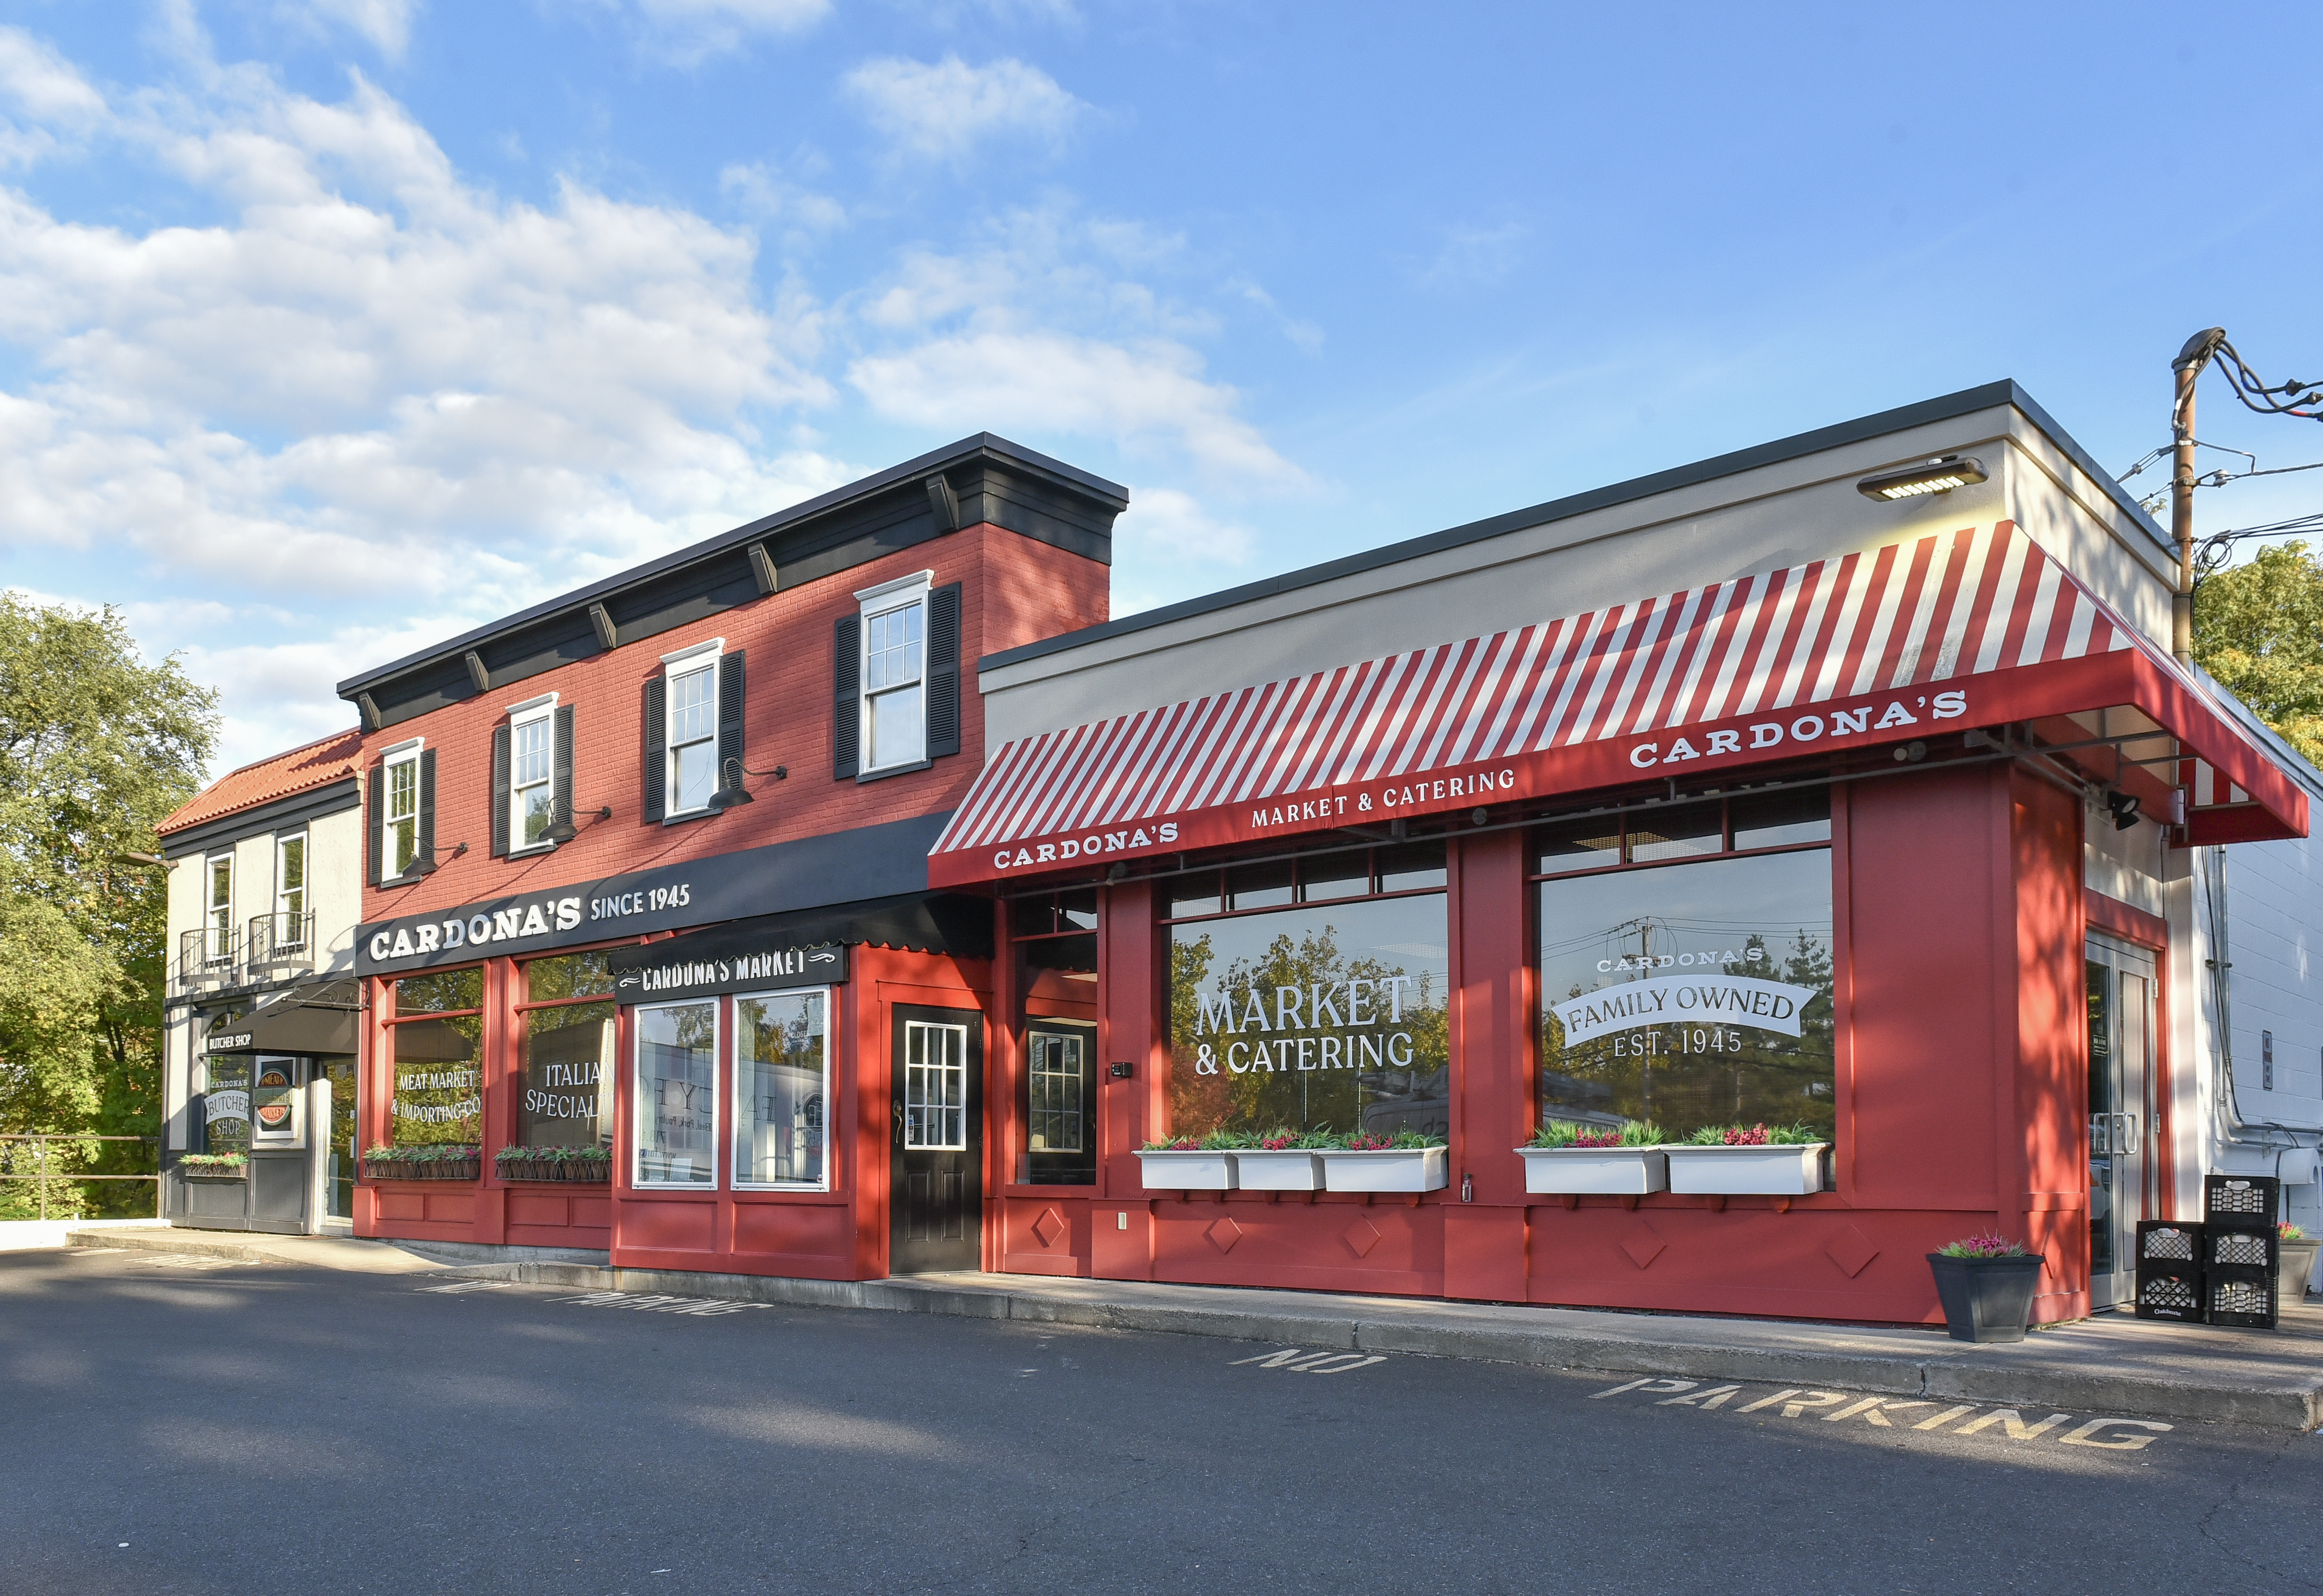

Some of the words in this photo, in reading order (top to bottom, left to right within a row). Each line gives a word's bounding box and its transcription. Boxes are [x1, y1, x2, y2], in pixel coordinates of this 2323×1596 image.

[1630, 690, 1967, 768] CARDONA'S
[1252, 796, 1347, 828] MARKET
[1358, 793, 1373, 811] &
[1383, 769, 1515, 808] CATERING
[994, 822, 1178, 869] CARDONA'S
[369, 897, 580, 961] CARDONA'S
[591, 892, 644, 921] SINCE
[649, 884, 690, 910] 1945
[736, 948, 804, 980] MARKET
[1596, 947, 1763, 973] CARDONA'S
[1196, 976, 1412, 1035] MARKET
[1567, 988, 1668, 1033] FAMILY
[1676, 986, 1794, 1019] OWNED
[209, 1036, 234, 1049] BUTCHER
[235, 1034, 251, 1046] SHOP
[1196, 1043, 1219, 1075] &
[1227, 1032, 1414, 1074] CATERING
[1615, 1032, 1668, 1057] EST.
[1682, 1029, 1742, 1053] 1945
[211, 1079, 247, 1088] CARDONA'S
[264, 1074, 280, 1085] MEAT
[399, 1074, 427, 1090] MEAT
[430, 1070, 475, 1088] MARKET
[546, 1062, 614, 1087] ITALIAN
[209, 1096, 249, 1116] BUTCHER
[391, 1099, 399, 1115] &
[401, 1102, 461, 1122] IMPORTING
[217, 1120, 240, 1135] SHOP
[544, 1292, 774, 1316] PARKING
[1226, 1349, 1388, 1374] NO
[1587, 1378, 2175, 1450] PARKING
